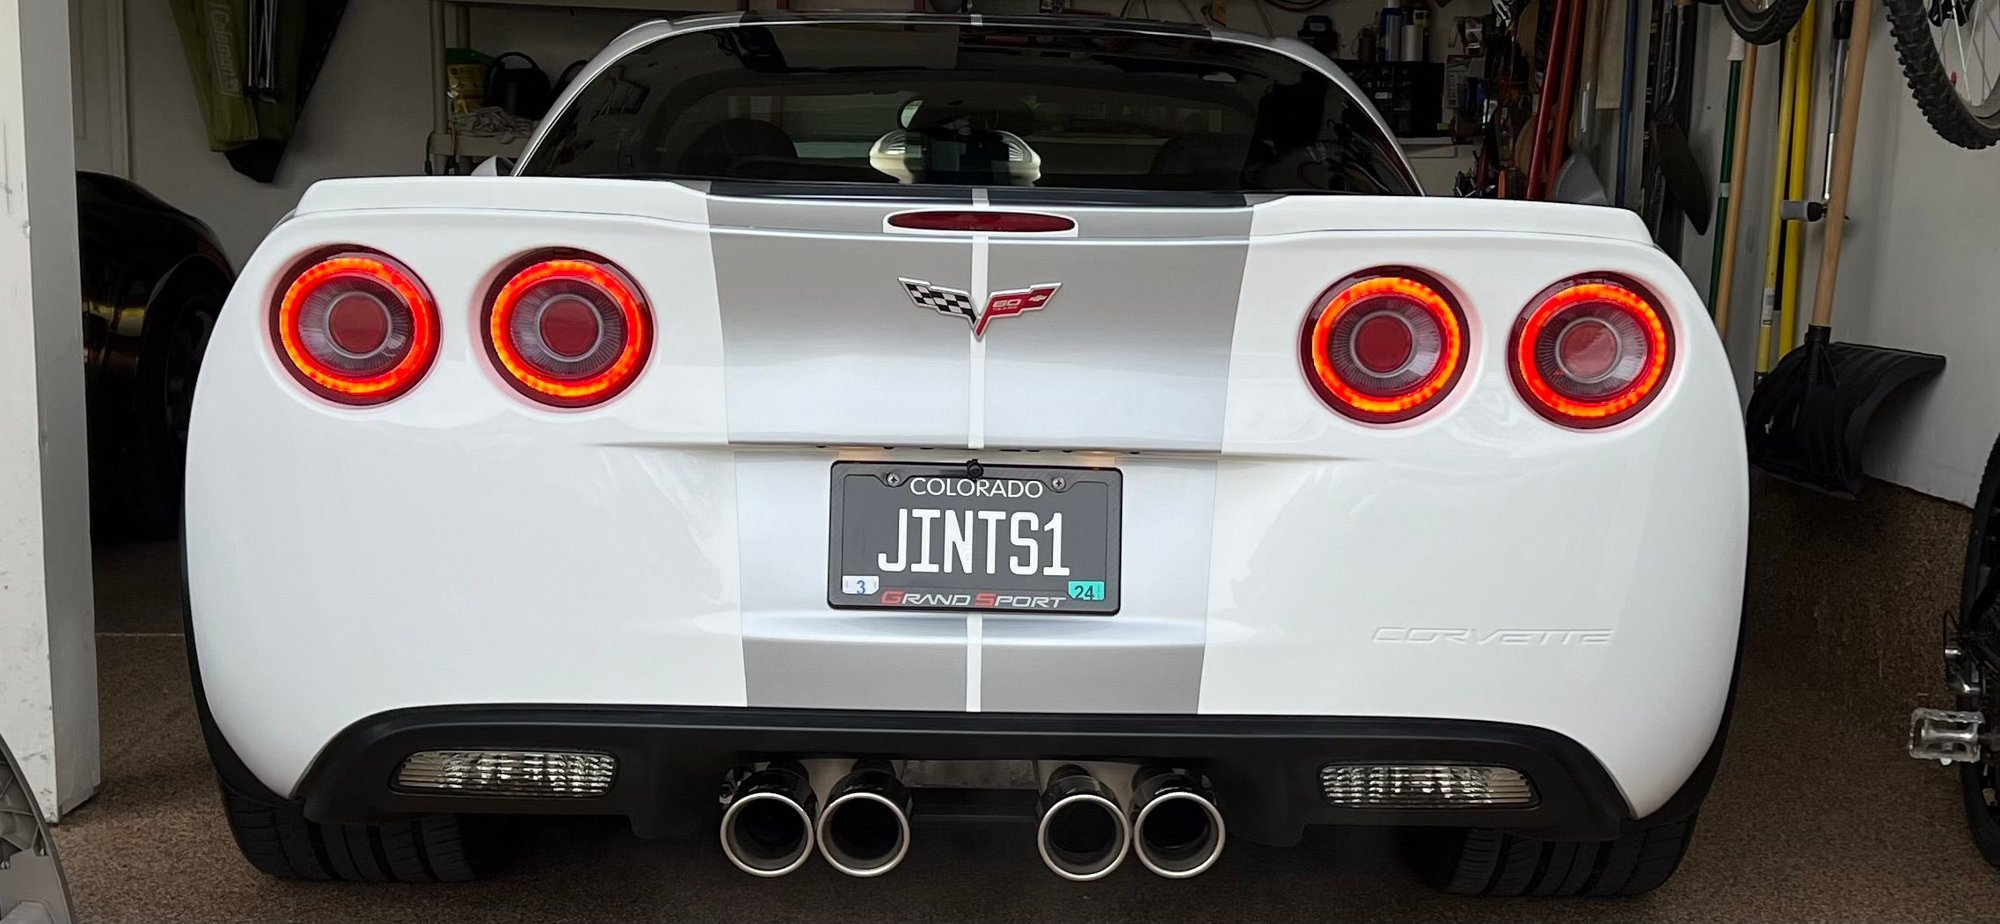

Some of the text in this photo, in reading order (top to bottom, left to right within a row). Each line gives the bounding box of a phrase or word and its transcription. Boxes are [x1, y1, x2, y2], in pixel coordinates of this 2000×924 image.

[210, 9, 236, 77] Coleman
[992, 299, 1022, 308] 60
[909, 477, 1043, 499] COLORADO
[877, 508, 1070, 576] JINTS1
[856, 580, 866, 595] 3
[1074, 584, 1095, 600] 24
[880, 591, 1066, 608] GRAND SPORT
[1372, 626, 1614, 645] CORVETTE
